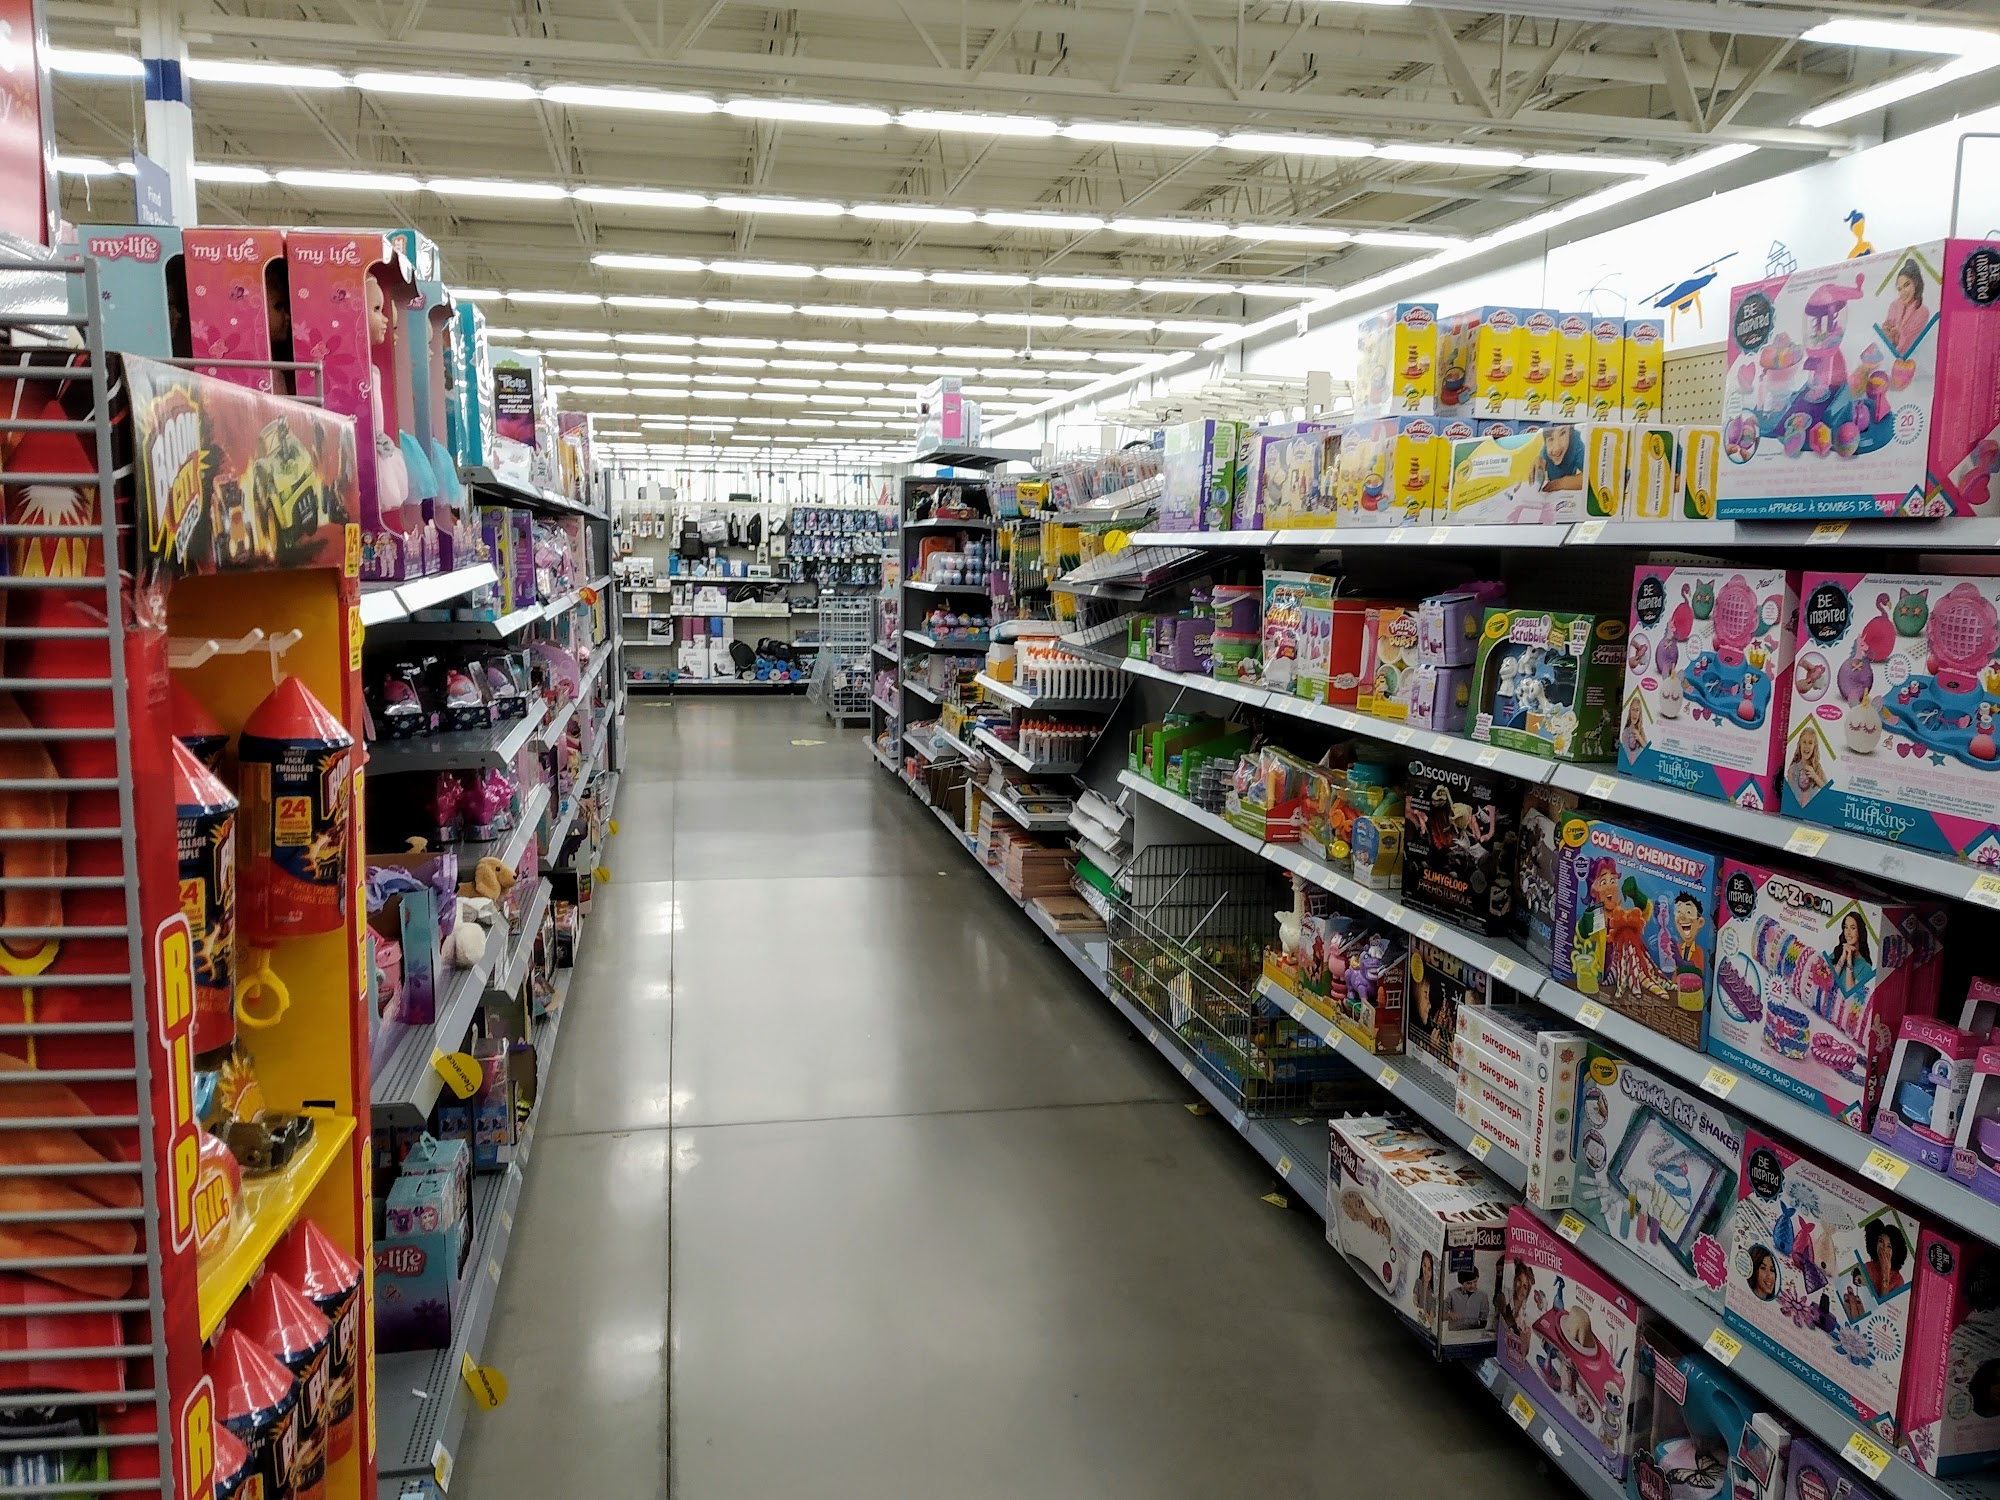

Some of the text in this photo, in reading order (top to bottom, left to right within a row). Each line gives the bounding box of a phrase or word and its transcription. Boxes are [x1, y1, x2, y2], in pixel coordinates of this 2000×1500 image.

[147, 185, 161, 207] Find
[191, 244, 221, 262] my
[295, 246, 323, 265] my
[1743, 302, 1758, 319] BE
[1901, 414, 1915, 427] 20
[1768, 501, 1806, 513] APPAREIL
[1817, 501, 1856, 513] BOMBES
[1858, 501, 1873, 512] DE
[1874, 500, 1896, 511] BAIN
[1643, 584, 1654, 596] BE
[1817, 593, 1833, 608] BE
[1809, 609, 1847, 625] inspired
[283, 772, 308, 782] SIMPLE
[1415, 760, 1472, 792] Discovery
[1418, 789, 1425, 798] 2
[280, 799, 306, 820] 24
[1636, 843, 1707, 879] CHEMISTRY
[1423, 868, 1469, 892] SLIMYGLOOP
[1733, 879, 1745, 890] BE
[1771, 981, 1782, 993] 24
[1482, 1032, 1521, 1062] spirograph
[1921, 1026, 1952, 1048] GLAM
[446, 1055, 475, 1093] Clearance
[1479, 1060, 1519, 1092] spirograph
[1744, 1057, 1771, 1080] RUBBER
[1772, 1071, 1791, 1088] BAND
[1791, 1081, 1816, 1102] LOOM!
[1482, 1087, 1522, 1122] spirograph
[1534, 1086, 1545, 1160] spirograph
[1480, 1116, 1520, 1152] spirograph
[1699, 1115, 1740, 1155] SHAKER
[1757, 1155, 1770, 1169] BE
[1875, 1157, 1895, 1172] $7.47
[1751, 1166, 1780, 1187] inspired
[1477, 1229, 1502, 1246] Bake
[1511, 1227, 1540, 1247] POTTERY
[1534, 1247, 1563, 1272] POTERIE
[1575, 1284, 1595, 1305] POTTERY
[477, 1368, 498, 1407] Clearance
[1787, 1355, 1811, 1377] CORPS
[1822, 1380, 1838, 1396] LES
[1838, 1392, 1870, 1420] ONGLES
[1856, 1440, 1880, 1464] $16.97
